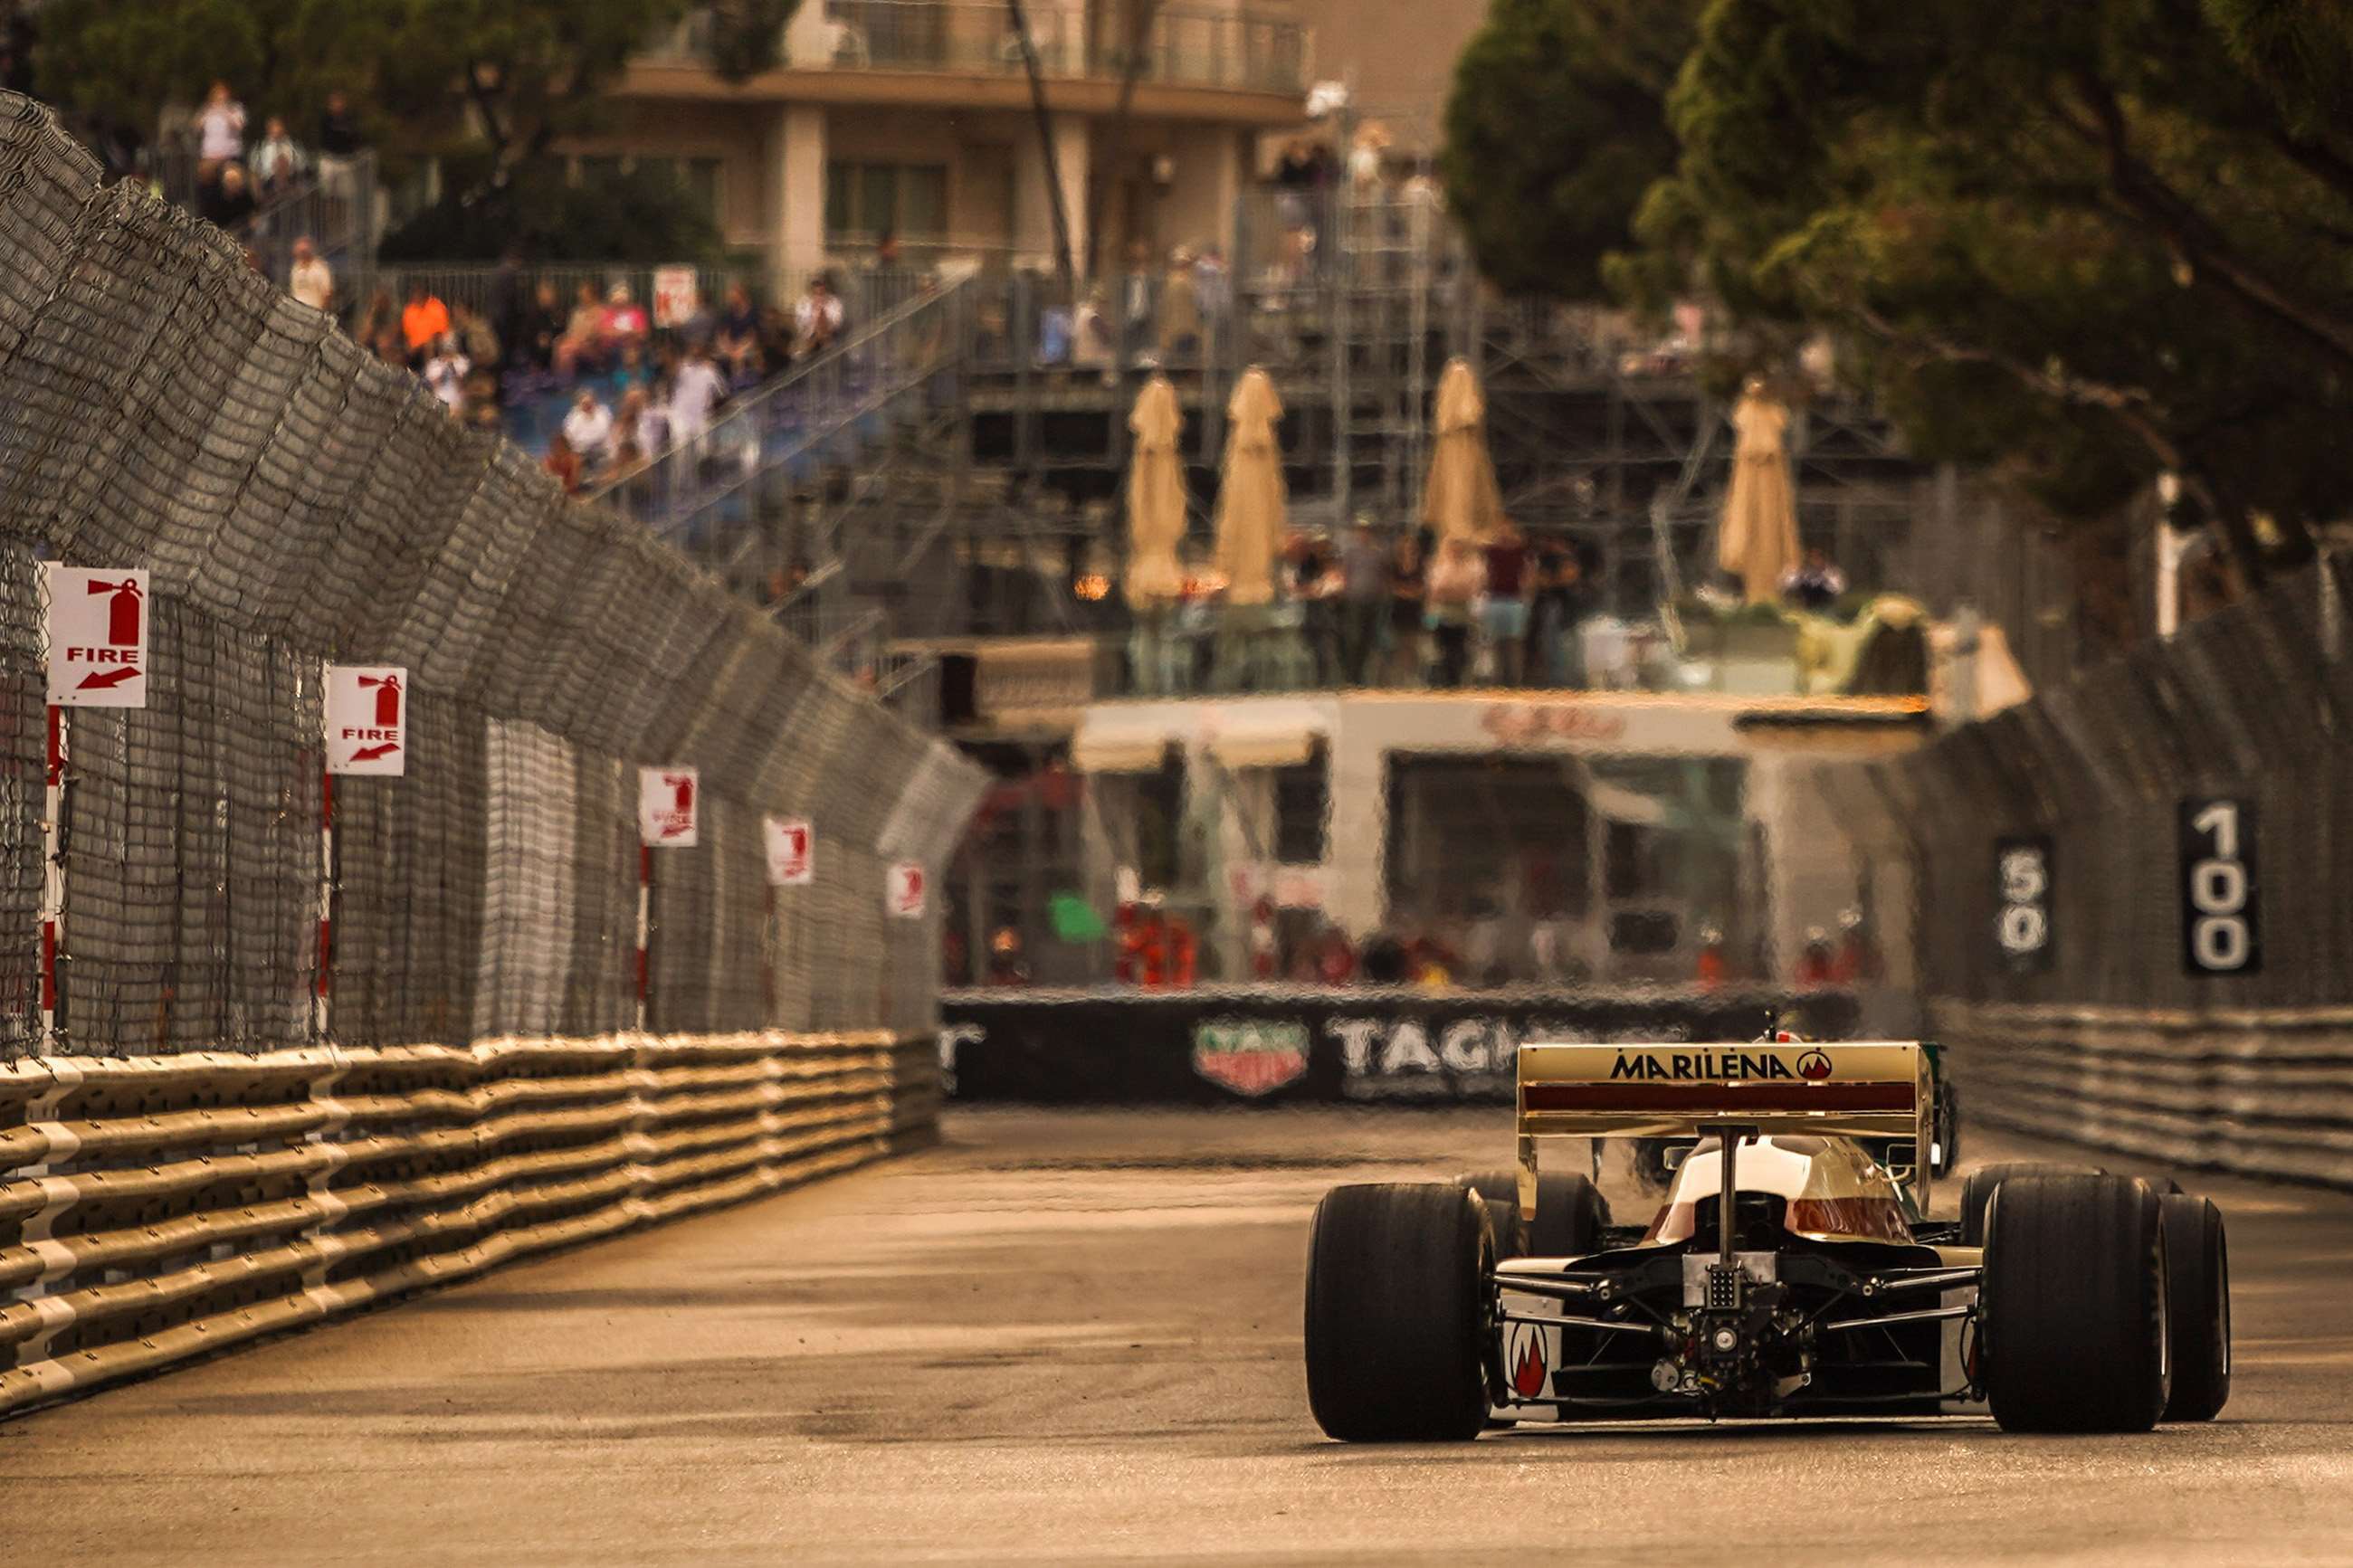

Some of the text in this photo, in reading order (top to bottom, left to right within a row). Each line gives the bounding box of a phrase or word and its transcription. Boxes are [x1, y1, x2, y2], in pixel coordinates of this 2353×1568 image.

[67, 647, 138, 663] FIRE
[341, 728, 399, 741] FIRE
[2192, 801, 2247, 970] 100
[1609, 1054, 1795, 1080] MARILENA
